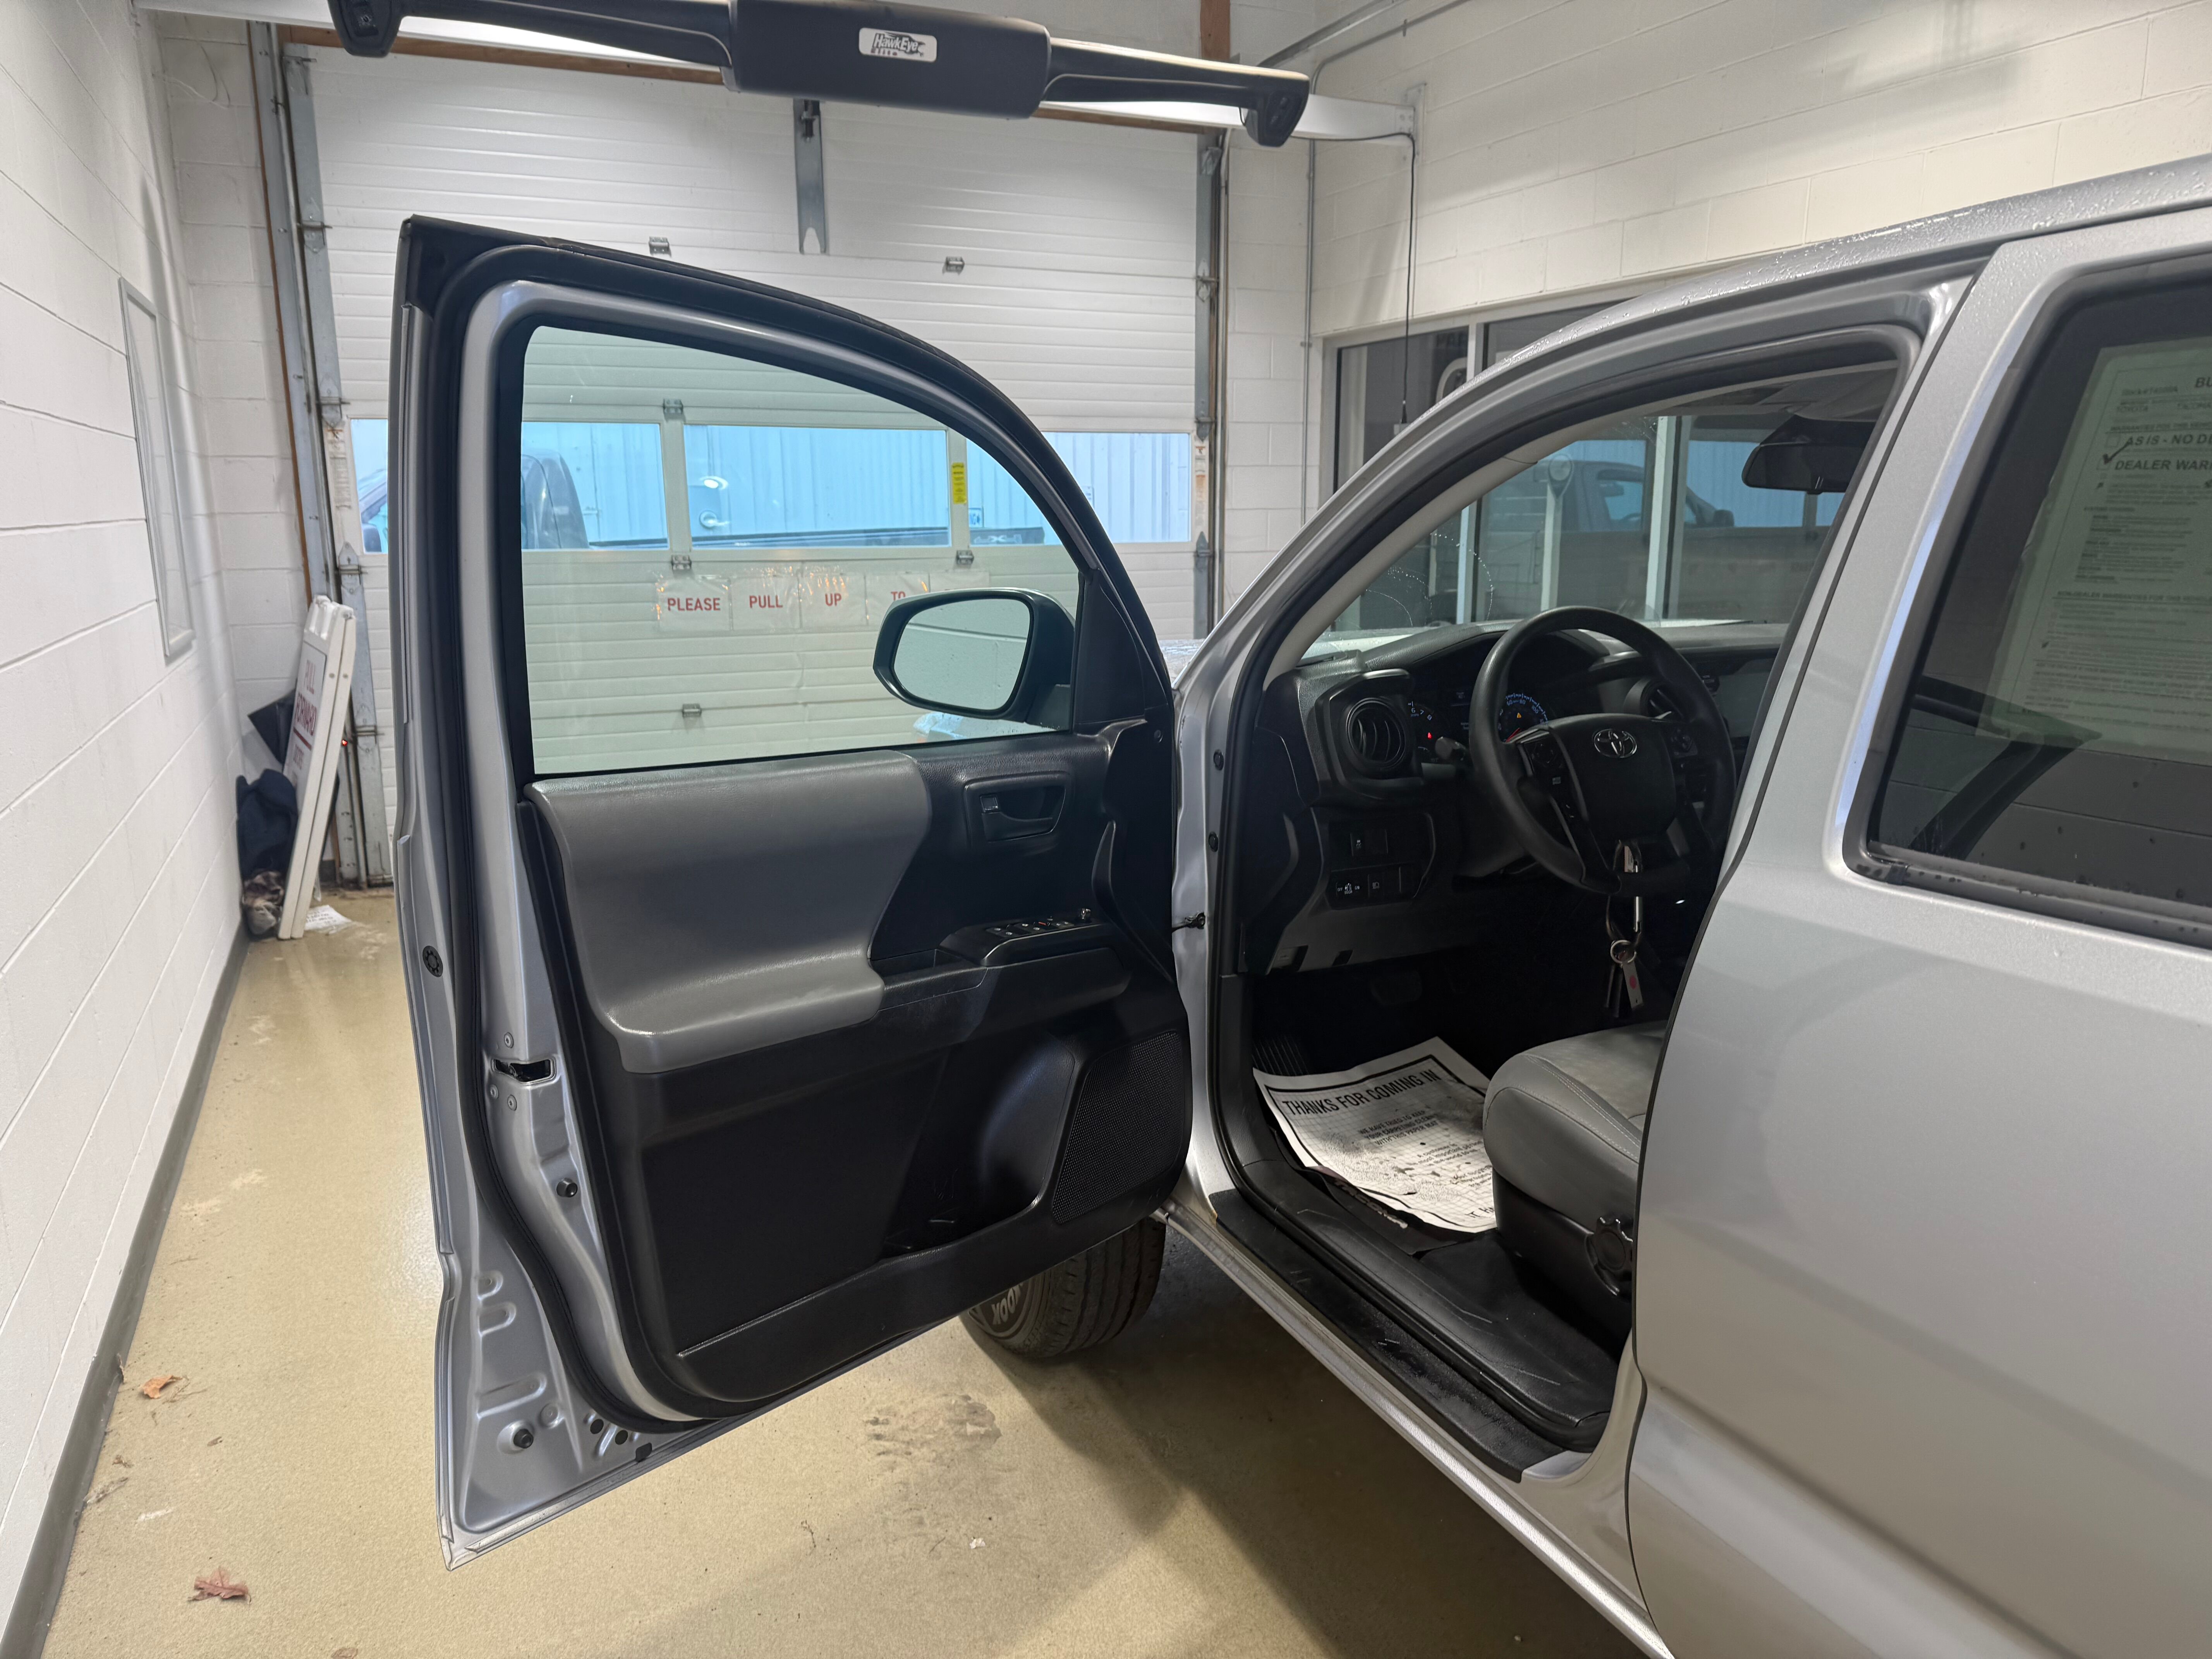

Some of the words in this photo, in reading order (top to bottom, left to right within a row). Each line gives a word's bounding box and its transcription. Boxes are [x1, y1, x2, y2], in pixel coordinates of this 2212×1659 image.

[872, 33, 919, 53] HawkEye
[2172, 434, 2193, 444] NO
[2115, 460, 2171, 470] DEALER
[667, 597, 721, 611] PLEASE
[749, 594, 783, 608] PULL
[824, 592, 842, 607] UP
[295, 692, 317, 736] FORWARD
[1282, 1099, 1341, 1116] THANKS
[1336, 1092, 1371, 1109] FOR
[1366, 1075, 1424, 1101] COMING
[1420, 1068, 1440, 1082] IN
[1369, 1122, 1385, 1131] HAVE
[1375, 1136, 1392, 1146] WITH
